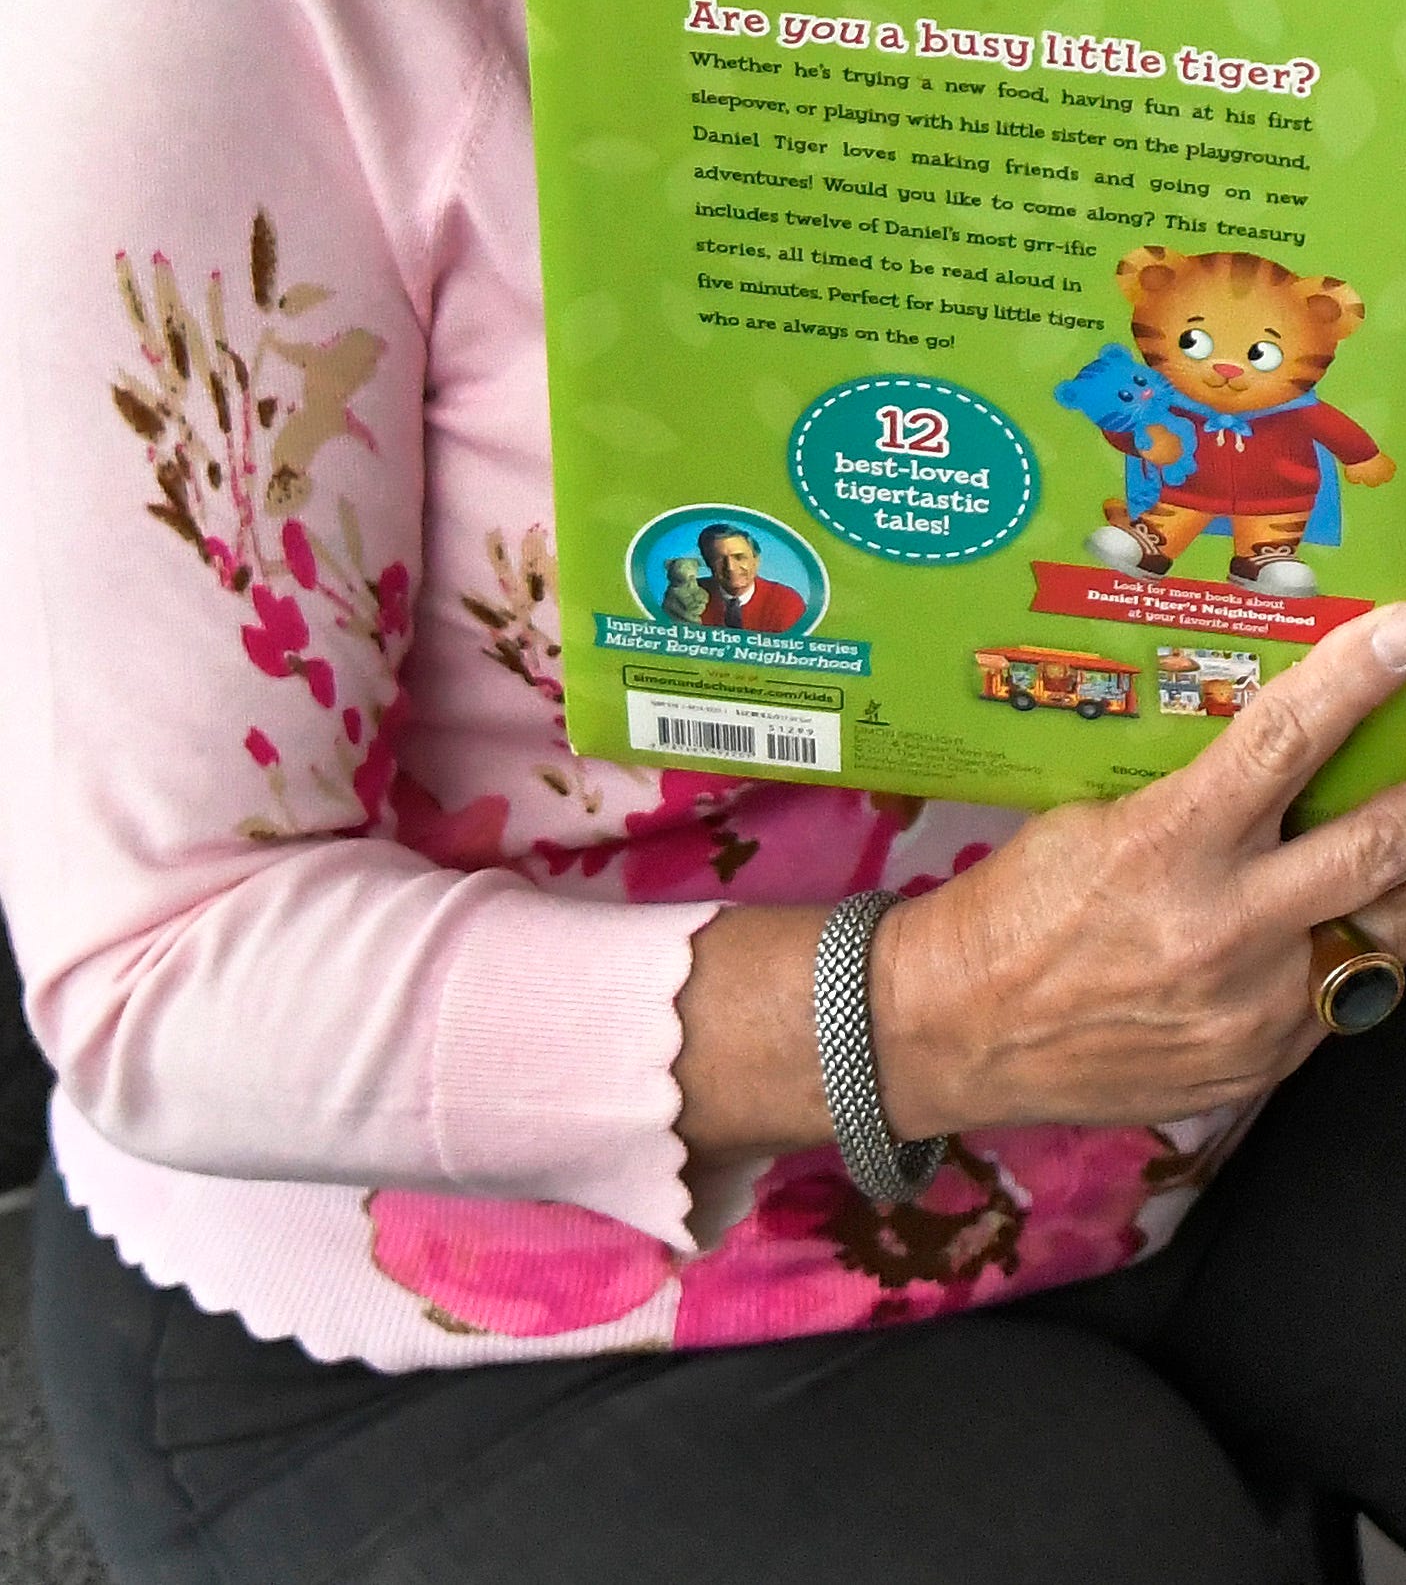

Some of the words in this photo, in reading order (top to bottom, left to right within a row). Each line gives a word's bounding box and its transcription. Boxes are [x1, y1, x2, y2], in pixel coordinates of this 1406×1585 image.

[780, 14, 866, 46] you
[879, 24, 906, 51] a
[919, 21, 1031, 68] busy
[1044, 33, 1162, 74] little
[1178, 50, 1316, 94] tiger?
[690, 51, 782, 74] Whether
[795, 63, 830, 79] he's
[843, 67, 909, 90] trying
[920, 79, 931, 90] a
[945, 80, 985, 95] new
[1062, 89, 1133, 112] having
[1144, 98, 1180, 117] fun
[1192, 104, 1213, 121] at
[1226, 108, 1255, 125] his
[1268, 112, 1313, 132] first
[691, 89, 790, 114] sleepover,
[796, 102, 817, 115] or
[824, 104, 900, 127] playing
[907, 113, 953, 131] with
[960, 116, 989, 134] his
[996, 120, 1045, 139] little
[1051, 127, 1107, 146] sister
[1113, 136, 1137, 151] on
[1145, 137, 1179, 154] the
[693, 125, 759, 147] Daniel
[775, 135, 828, 154] Tiger
[843, 141, 896, 162] loves
[912, 151, 990, 173] making
[1006, 158, 1079, 182] friends
[1095, 170, 1135, 189] and
[1150, 177, 1210, 198] going
[1225, 186, 1251, 200] on
[1266, 190, 1309, 207] new
[694, 165, 814, 190] adventures!
[823, 176, 888, 198] Would
[897, 187, 936, 204] you
[946, 189, 982, 207] like
[991, 195, 1014, 212] to
[1023, 201, 1077, 218] come
[1087, 206, 1155, 228] along?
[1166, 214, 1207, 233] This
[1217, 220, 1306, 247] treasury
[695, 202, 779, 223] includes
[785, 210, 852, 230] twelve
[858, 218, 880, 234] of
[885, 220, 960, 242] Daniel's
[966, 230, 1018, 249] most
[1023, 237, 1097, 257] grr-ific
[696, 238, 772, 260] stories,
[778, 246, 804, 262] all
[811, 249, 873, 270] timed
[880, 256, 903, 272] to
[910, 259, 935, 275] be
[941, 267, 988, 283] read
[996, 270, 1055, 290] aloud
[1062, 277, 1082, 292] in
[697, 272, 734, 290] five
[740, 280, 823, 301] minutes.
[828, 287, 899, 308] Perfect
[906, 294, 934, 311] for
[940, 299, 989, 320] busy
[993, 304, 1041, 323] little
[1047, 310, 1105, 331] tigers
[698, 311, 740, 328] who
[745, 318, 777, 330] are
[783, 320, 849, 340] always
[855, 330, 879, 342] on
[886, 329, 920, 346] the
[926, 336, 956, 350] go!
[878, 407, 947, 455] 12
[834, 452, 990, 489] best-loved
[834, 478, 990, 513] tigertastic
[874, 508, 950, 536] tales!
[1087, 589, 1140, 607] Daniel
[1142, 597, 1198, 614] Tiger's
[1201, 603, 1316, 627] Neighborhood
[1112, 579, 1144, 593] Look
[1147, 583, 1167, 597] for
[1169, 588, 1202, 600] more
[1204, 591, 1243, 605] books
[1246, 595, 1285, 610] about
[606, 617, 678, 639] Inspired
[683, 626, 706, 643] by
[712, 630, 741, 644] the
[747, 633, 803, 651] classic
[808, 641, 859, 656] series
[1127, 608, 1143, 619] at
[1145, 612, 1176, 624] your
[1179, 613, 1230, 630] favorite
[1232, 620, 1269, 634] store!
[604, 632, 662, 651] Mister
[665, 640, 731, 658] Rogers'
[733, 647, 863, 672] Neighborhood
[633, 672, 834, 704] simonandschuster.com/kids
